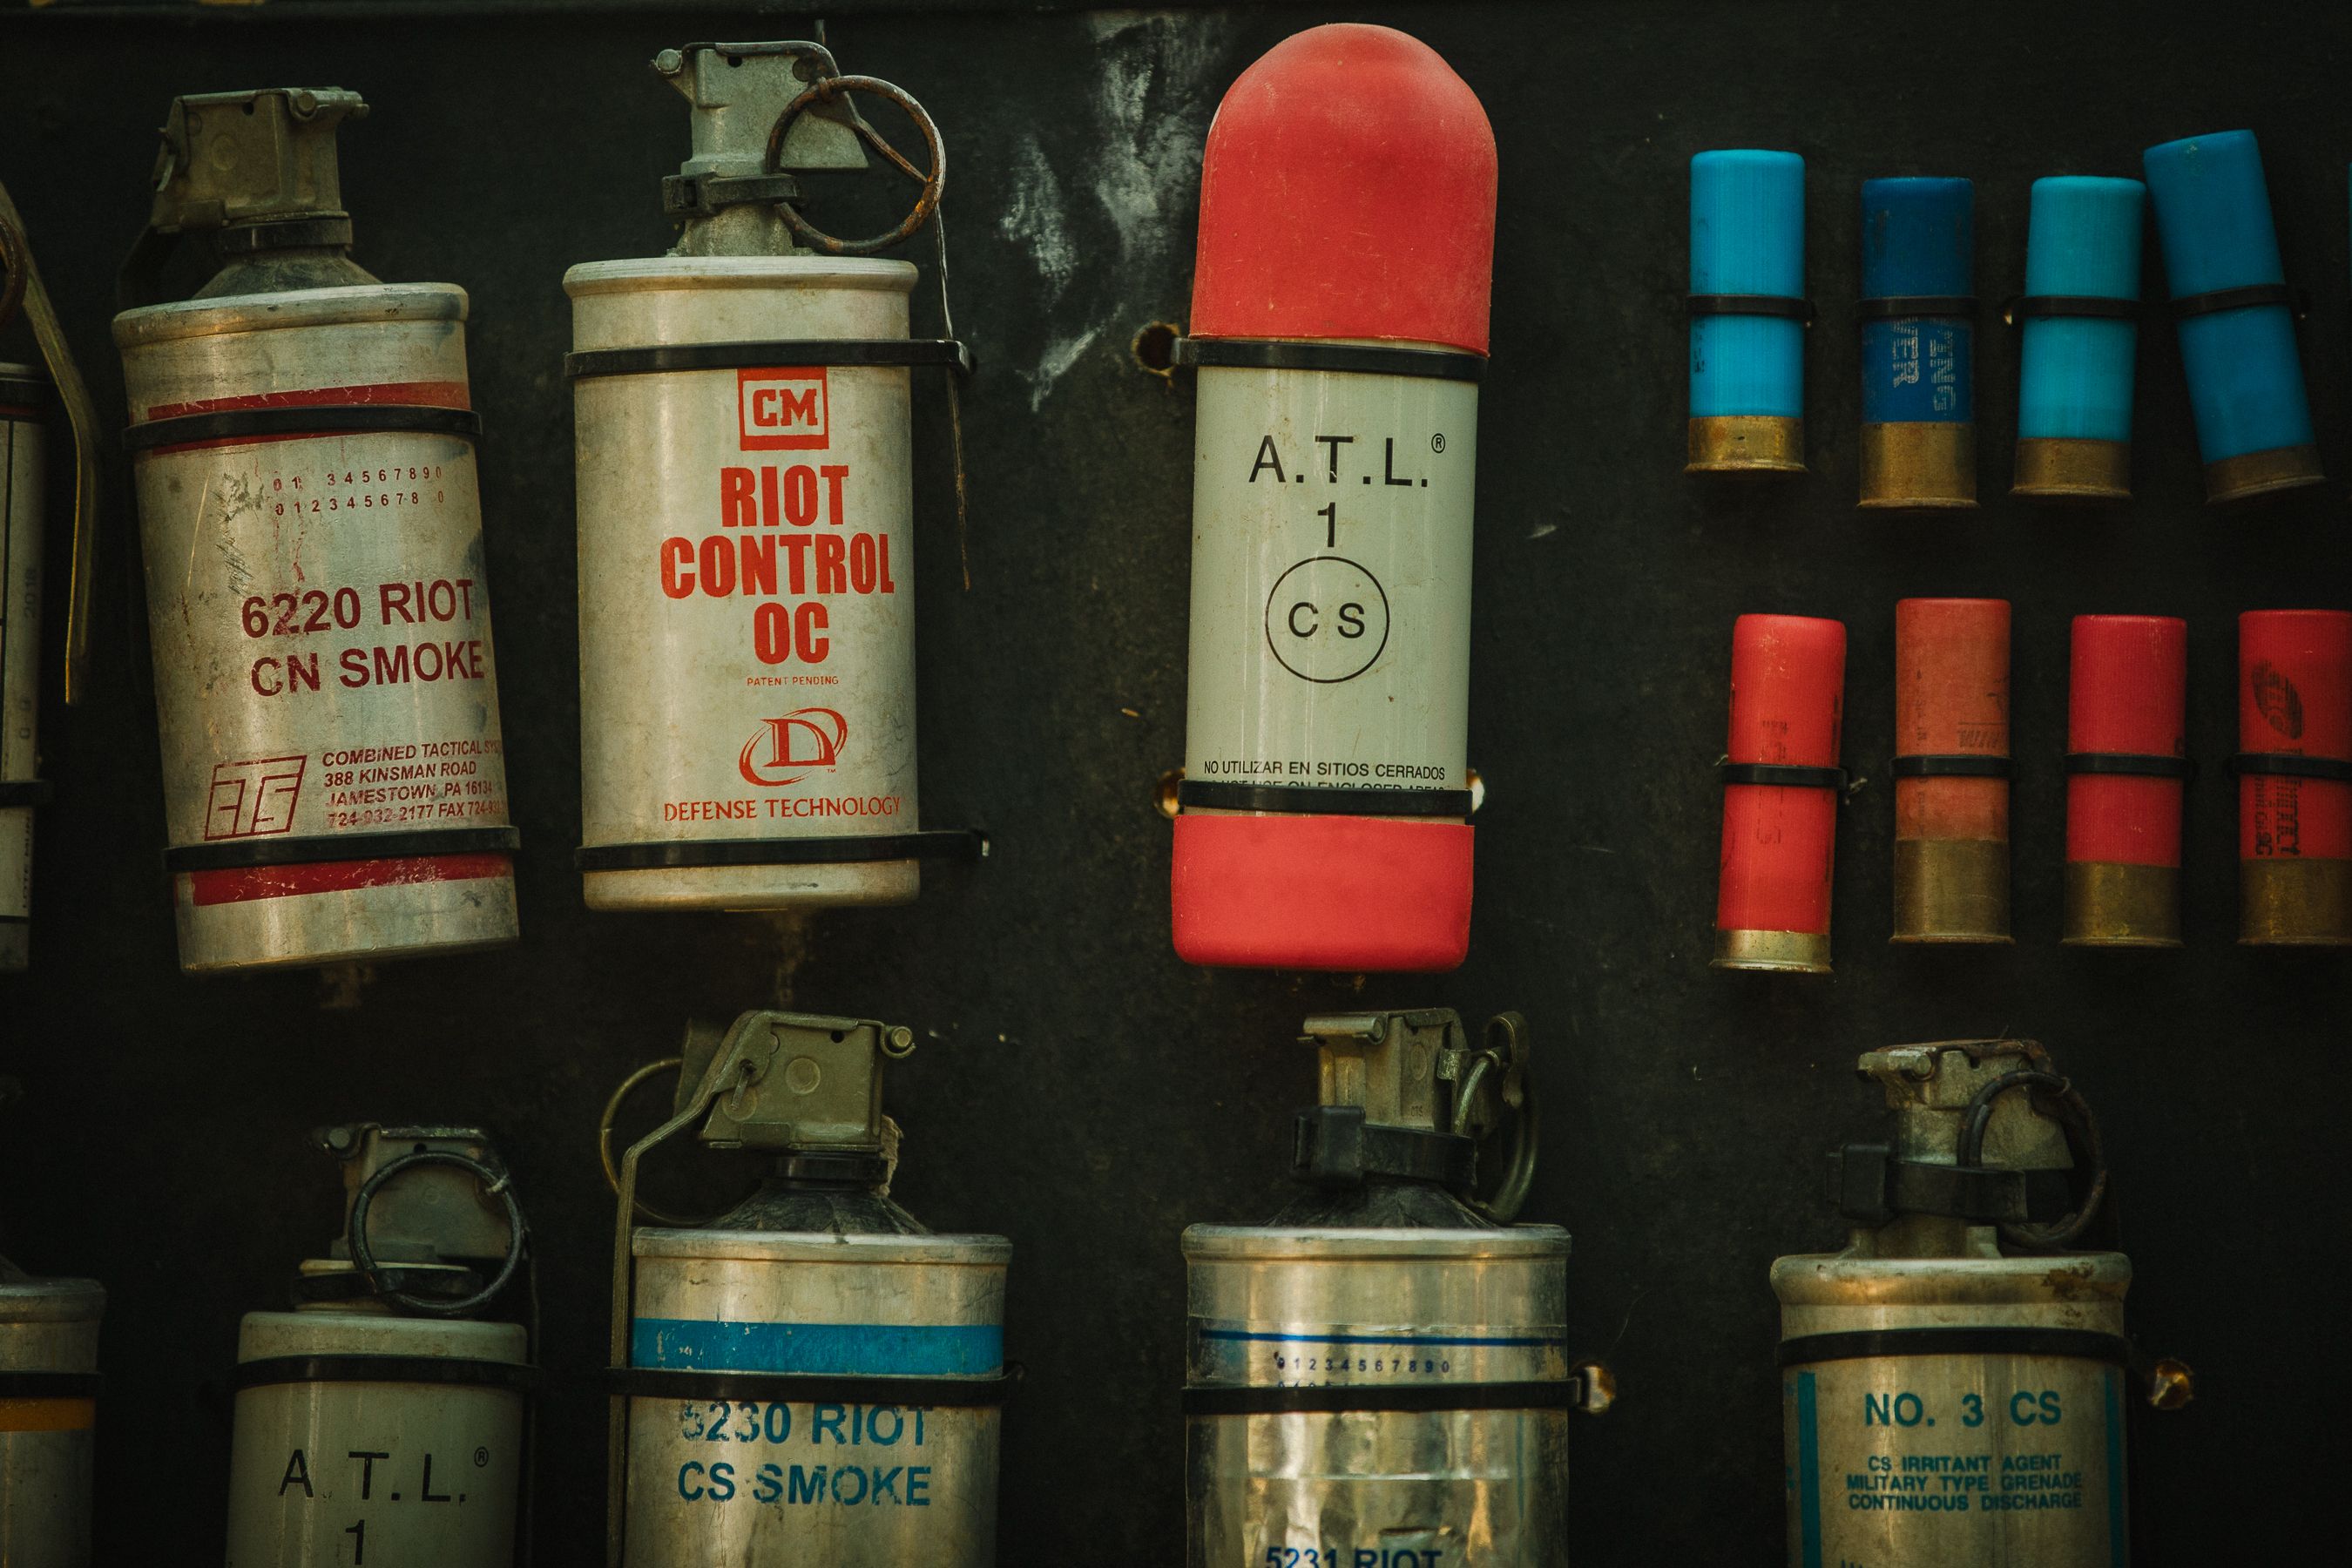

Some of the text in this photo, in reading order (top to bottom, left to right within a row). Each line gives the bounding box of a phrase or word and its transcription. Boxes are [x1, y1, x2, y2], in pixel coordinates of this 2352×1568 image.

[753, 389, 818, 427] CM
[720, 464, 849, 528] RIOT
[1317, 501, 1336, 548] 1
[659, 532, 895, 599] CONTROL
[241, 578, 473, 639] 6220 RIOT
[754, 602, 829, 665] OC
[251, 640, 485, 697] CN SMOKE
[747, 675, 839, 686] PATENT PENDING
[322, 745, 416, 767] COMBINED
[422, 740, 482, 758] TACTICAL
[324, 760, 476, 787] 388 KINSMAN ROAD
[1204, 760, 1446, 781] NO UTILIZAR EN SITIOS CERRADOS
[444, 782, 461, 797] PA
[438, 802, 464, 817] FAX
[664, 796, 900, 821] DEFENSE TECHNOLOGY
[811, 1402, 933, 1446] RIOT
[1865, 1390, 2062, 1427] NO. 3 CS
[1868, 1454, 2062, 1472] CS IRRITANT AGENT
[678, 1461, 931, 1506] CS SMOKE
[1847, 1472, 2082, 1492] MILITARY TYPE GRENADE
[1848, 1491, 2083, 1511] CONTINUOUS DISCHARGE
[345, 1519, 365, 1565] 1
[1355, 1548, 1442, 1568] RIOT
